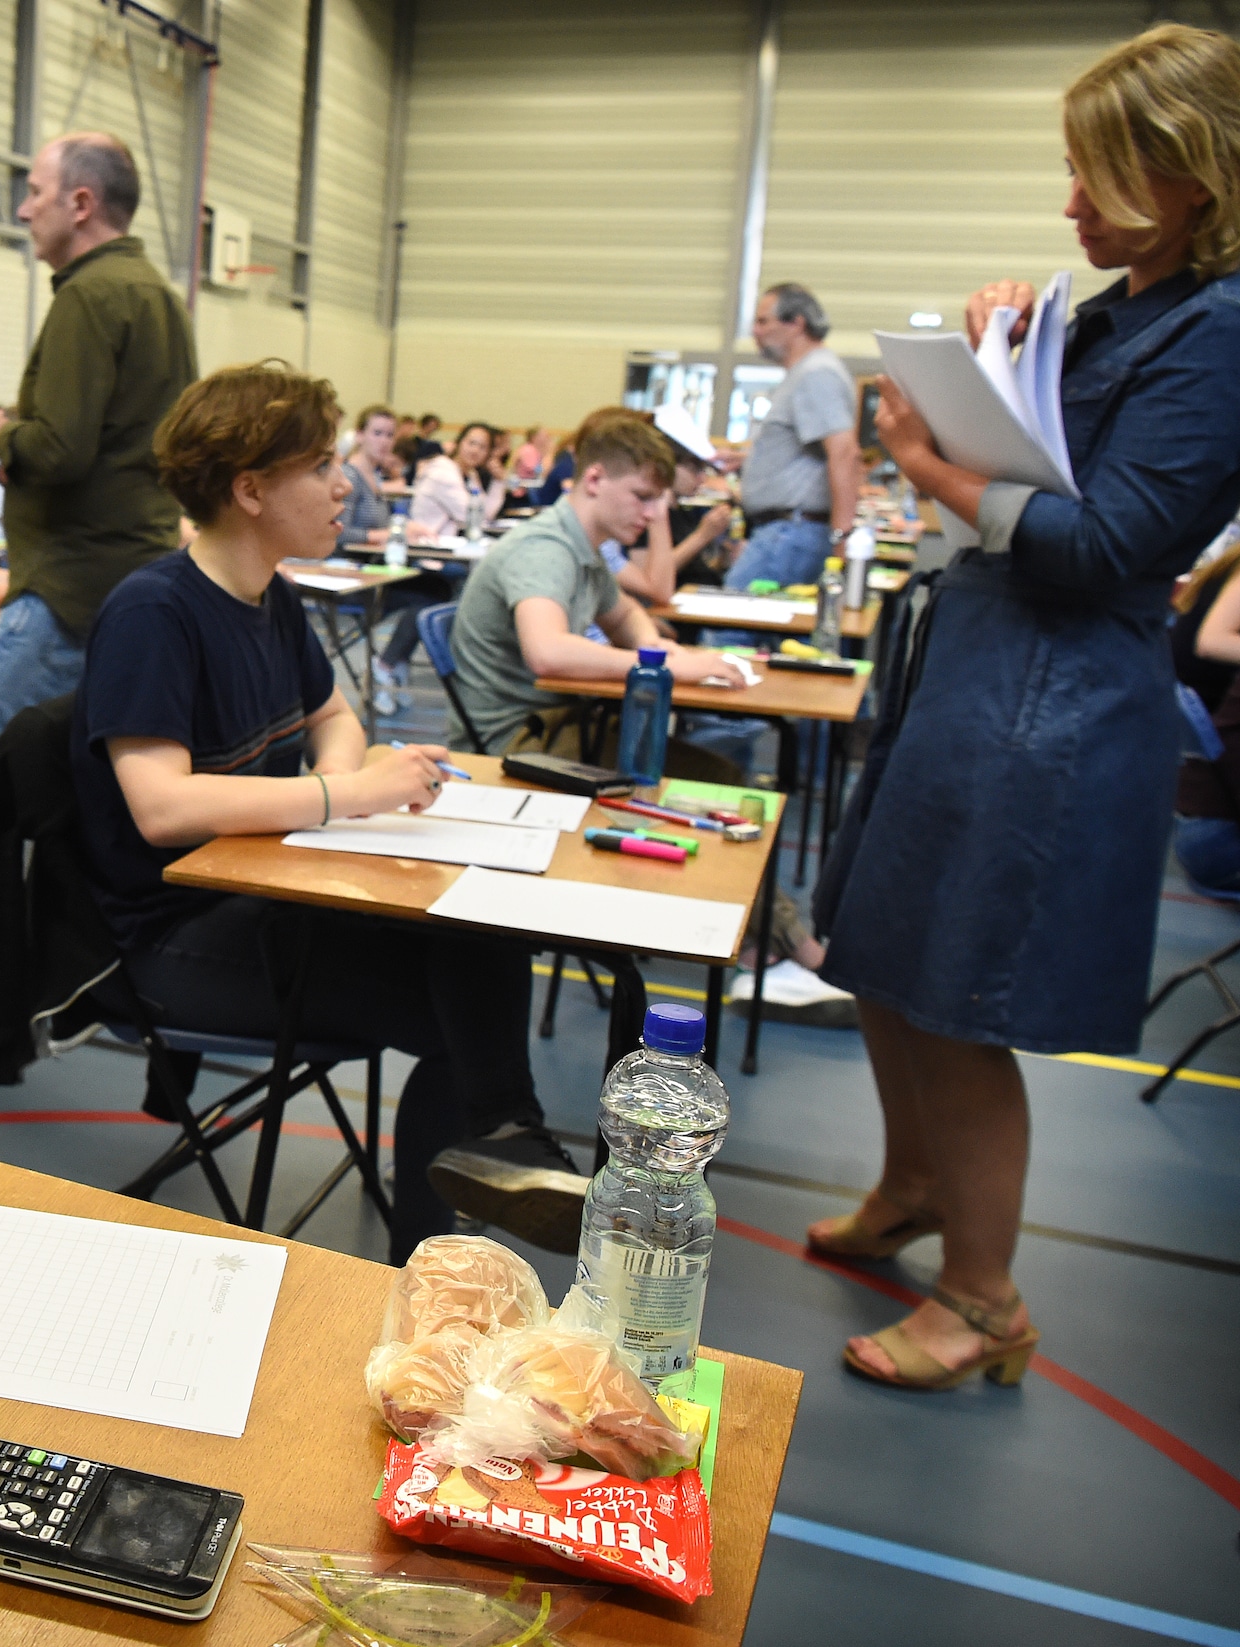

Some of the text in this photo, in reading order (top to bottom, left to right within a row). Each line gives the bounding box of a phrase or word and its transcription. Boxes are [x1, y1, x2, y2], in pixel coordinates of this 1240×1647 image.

[485, 1459, 517, 1475] Natu
[580, 1486, 649, 1507] Lekker
[566, 1498, 659, 1532] Dubbel
